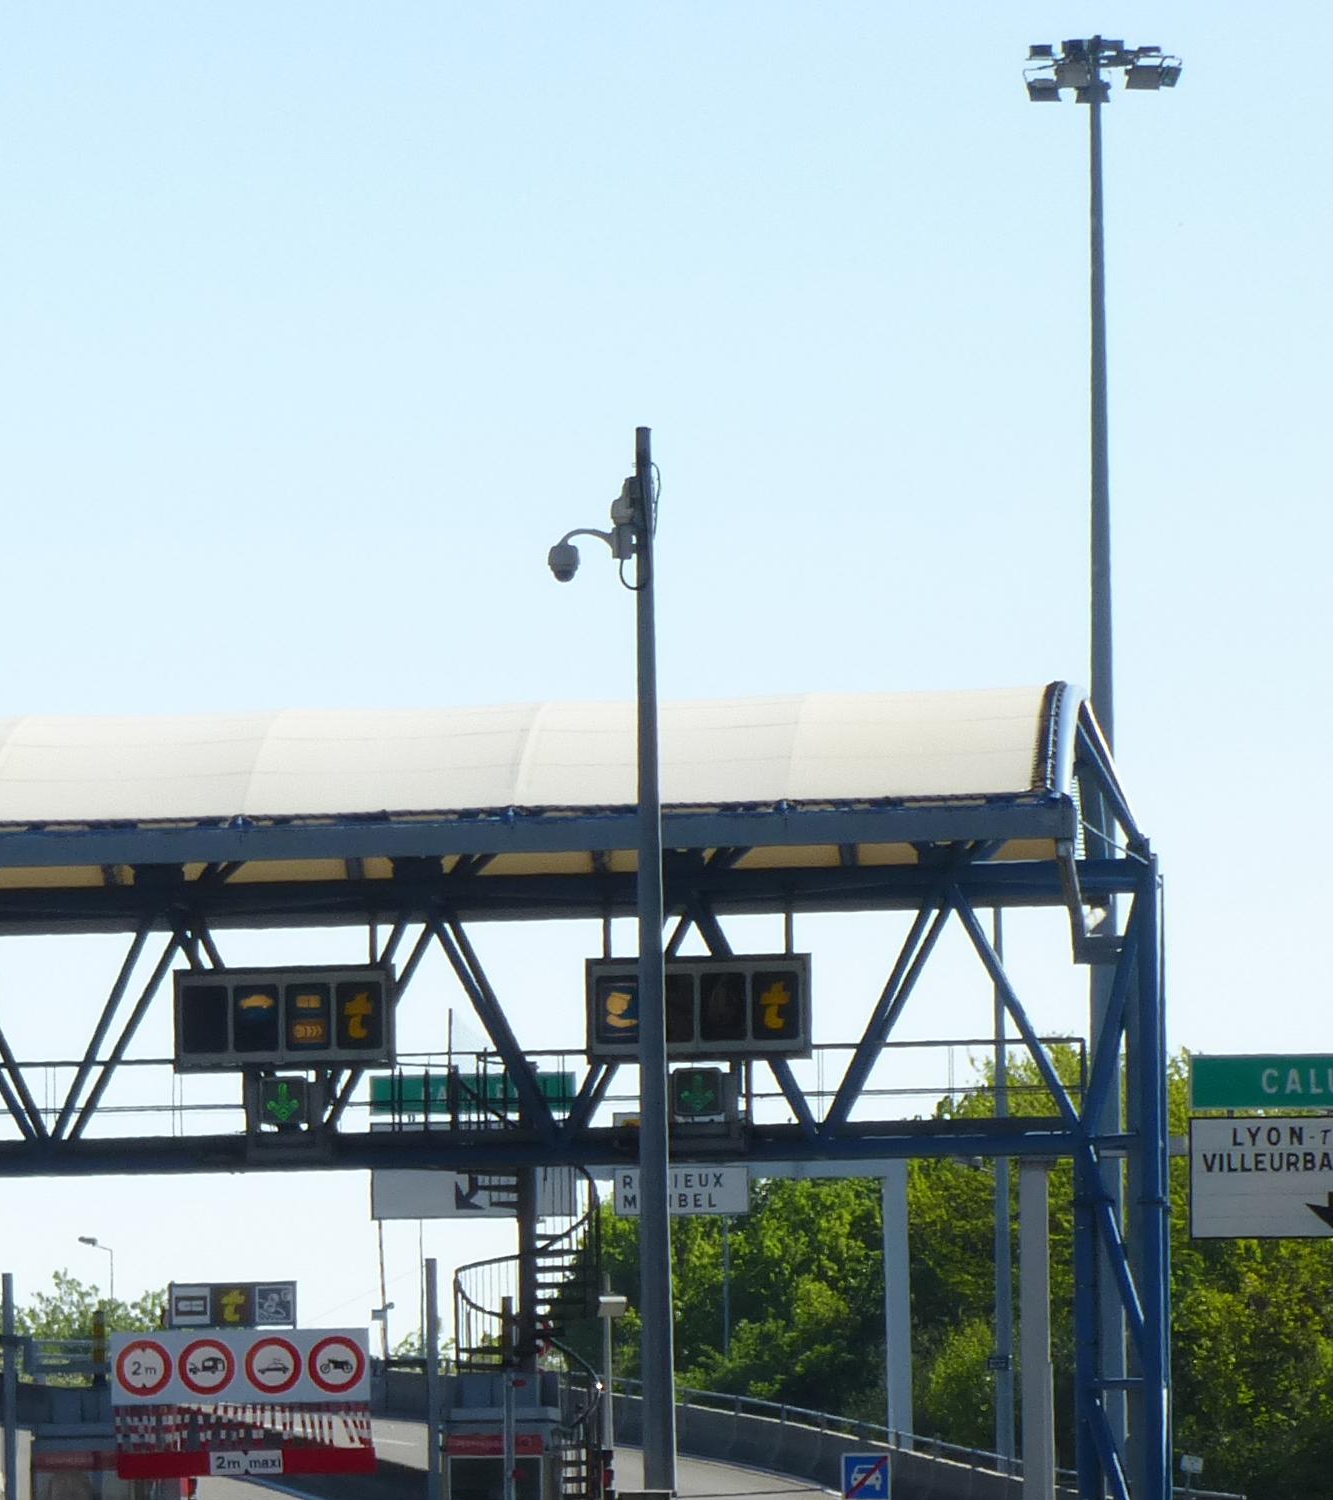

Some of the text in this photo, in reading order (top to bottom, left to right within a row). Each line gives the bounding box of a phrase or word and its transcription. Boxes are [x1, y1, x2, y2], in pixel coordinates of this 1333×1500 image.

[623, 1173, 724, 1189] RIEUX
[623, 1193, 718, 1209] MIBEL
[249, 1456, 282, 1469] maxi
